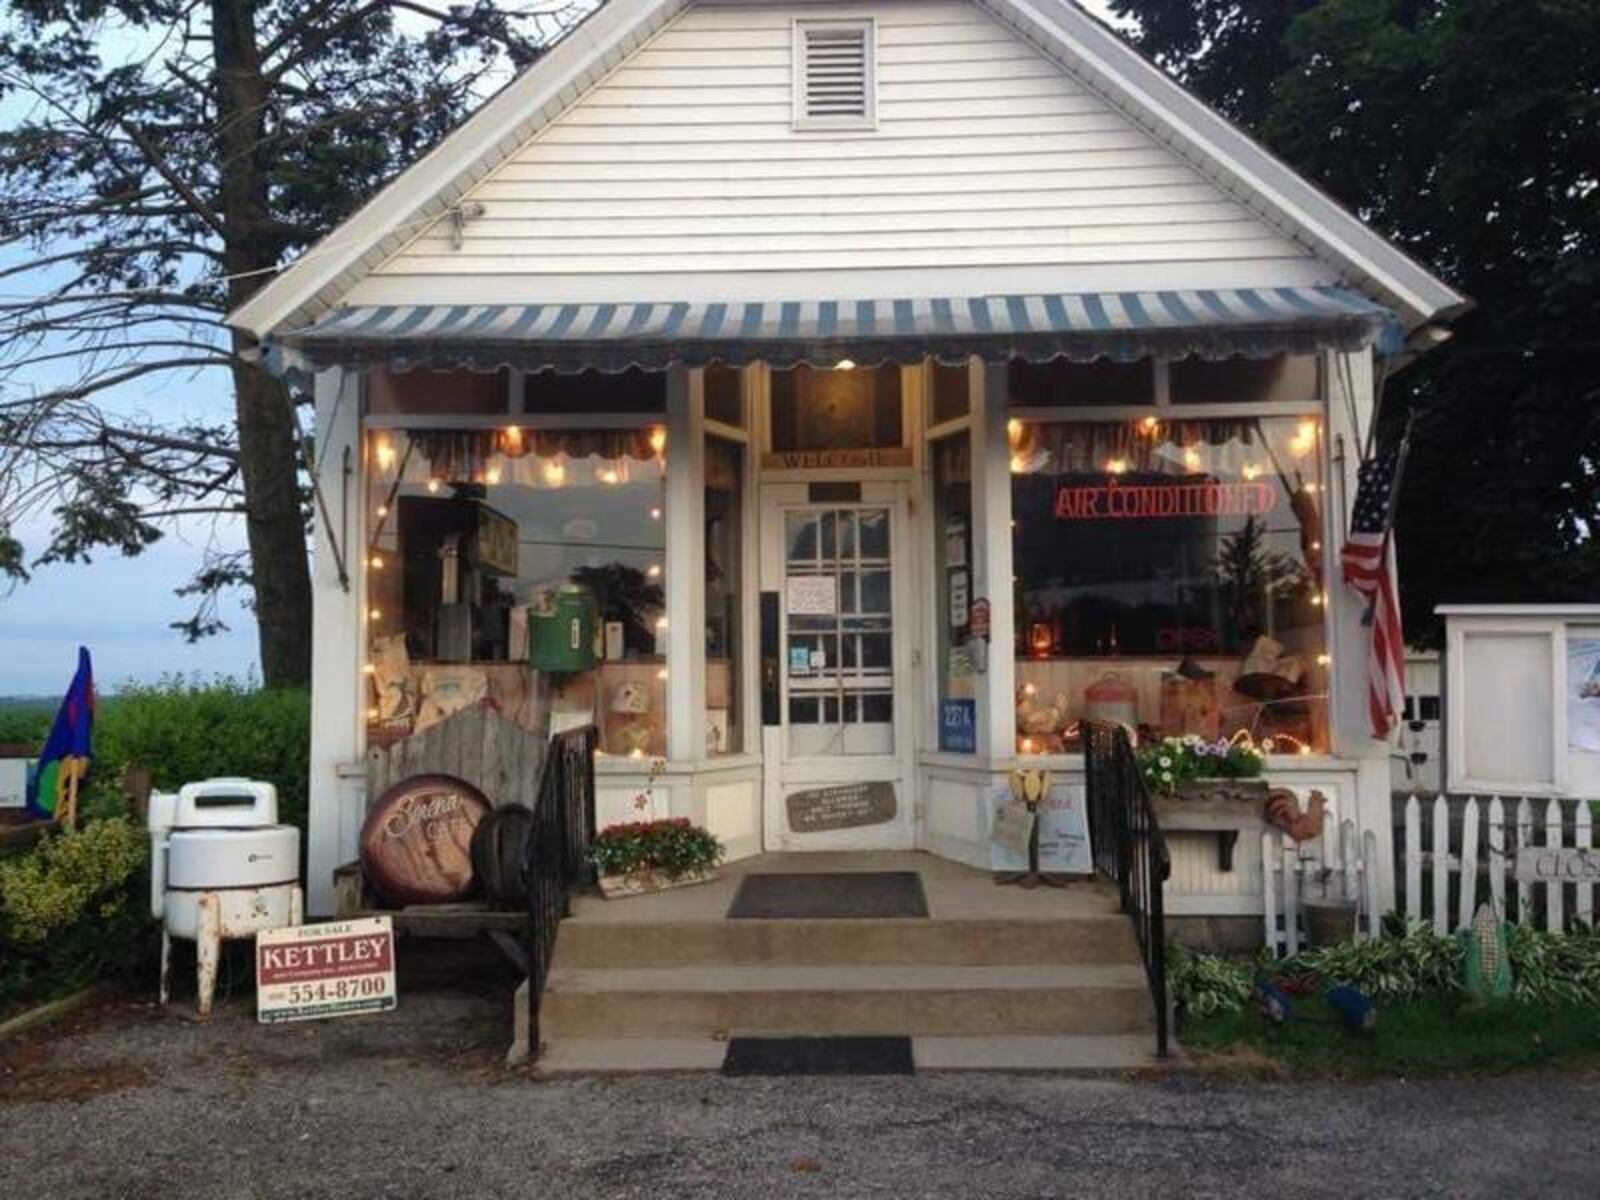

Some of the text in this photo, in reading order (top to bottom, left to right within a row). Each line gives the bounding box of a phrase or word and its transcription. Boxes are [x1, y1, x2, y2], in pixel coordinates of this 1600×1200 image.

[1056, 480, 1276, 517] AIR CONDITIONED
[263, 938, 386, 968] KETTLEY
[288, 976, 386, 1004] 554-8700
